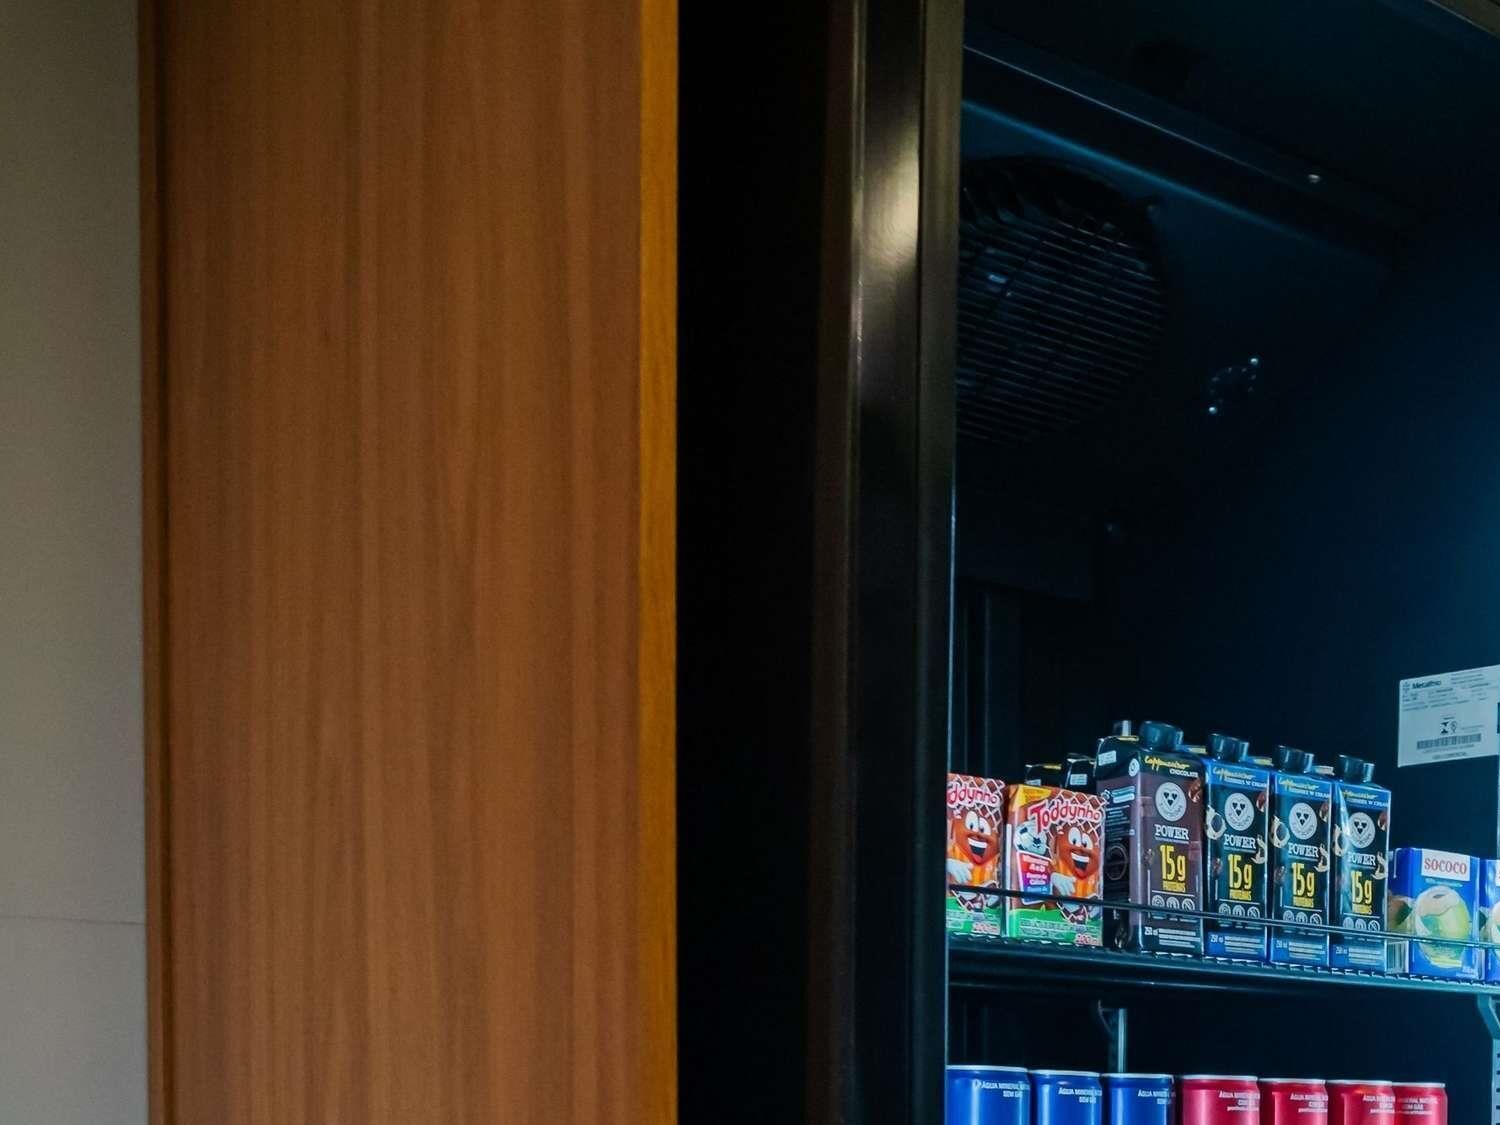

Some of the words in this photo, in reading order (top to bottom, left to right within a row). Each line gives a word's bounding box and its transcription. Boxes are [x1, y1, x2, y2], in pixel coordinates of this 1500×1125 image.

[947, 783, 999, 807] ddynho
[1029, 802, 1102, 833] Toddynho
[1154, 824, 1189, 840] POWER
[1223, 834, 1256, 849] POWER
[1287, 842, 1319, 857] POWER
[1348, 851, 1376, 866] POWER
[1424, 858, 1467, 875] SOCOCO
